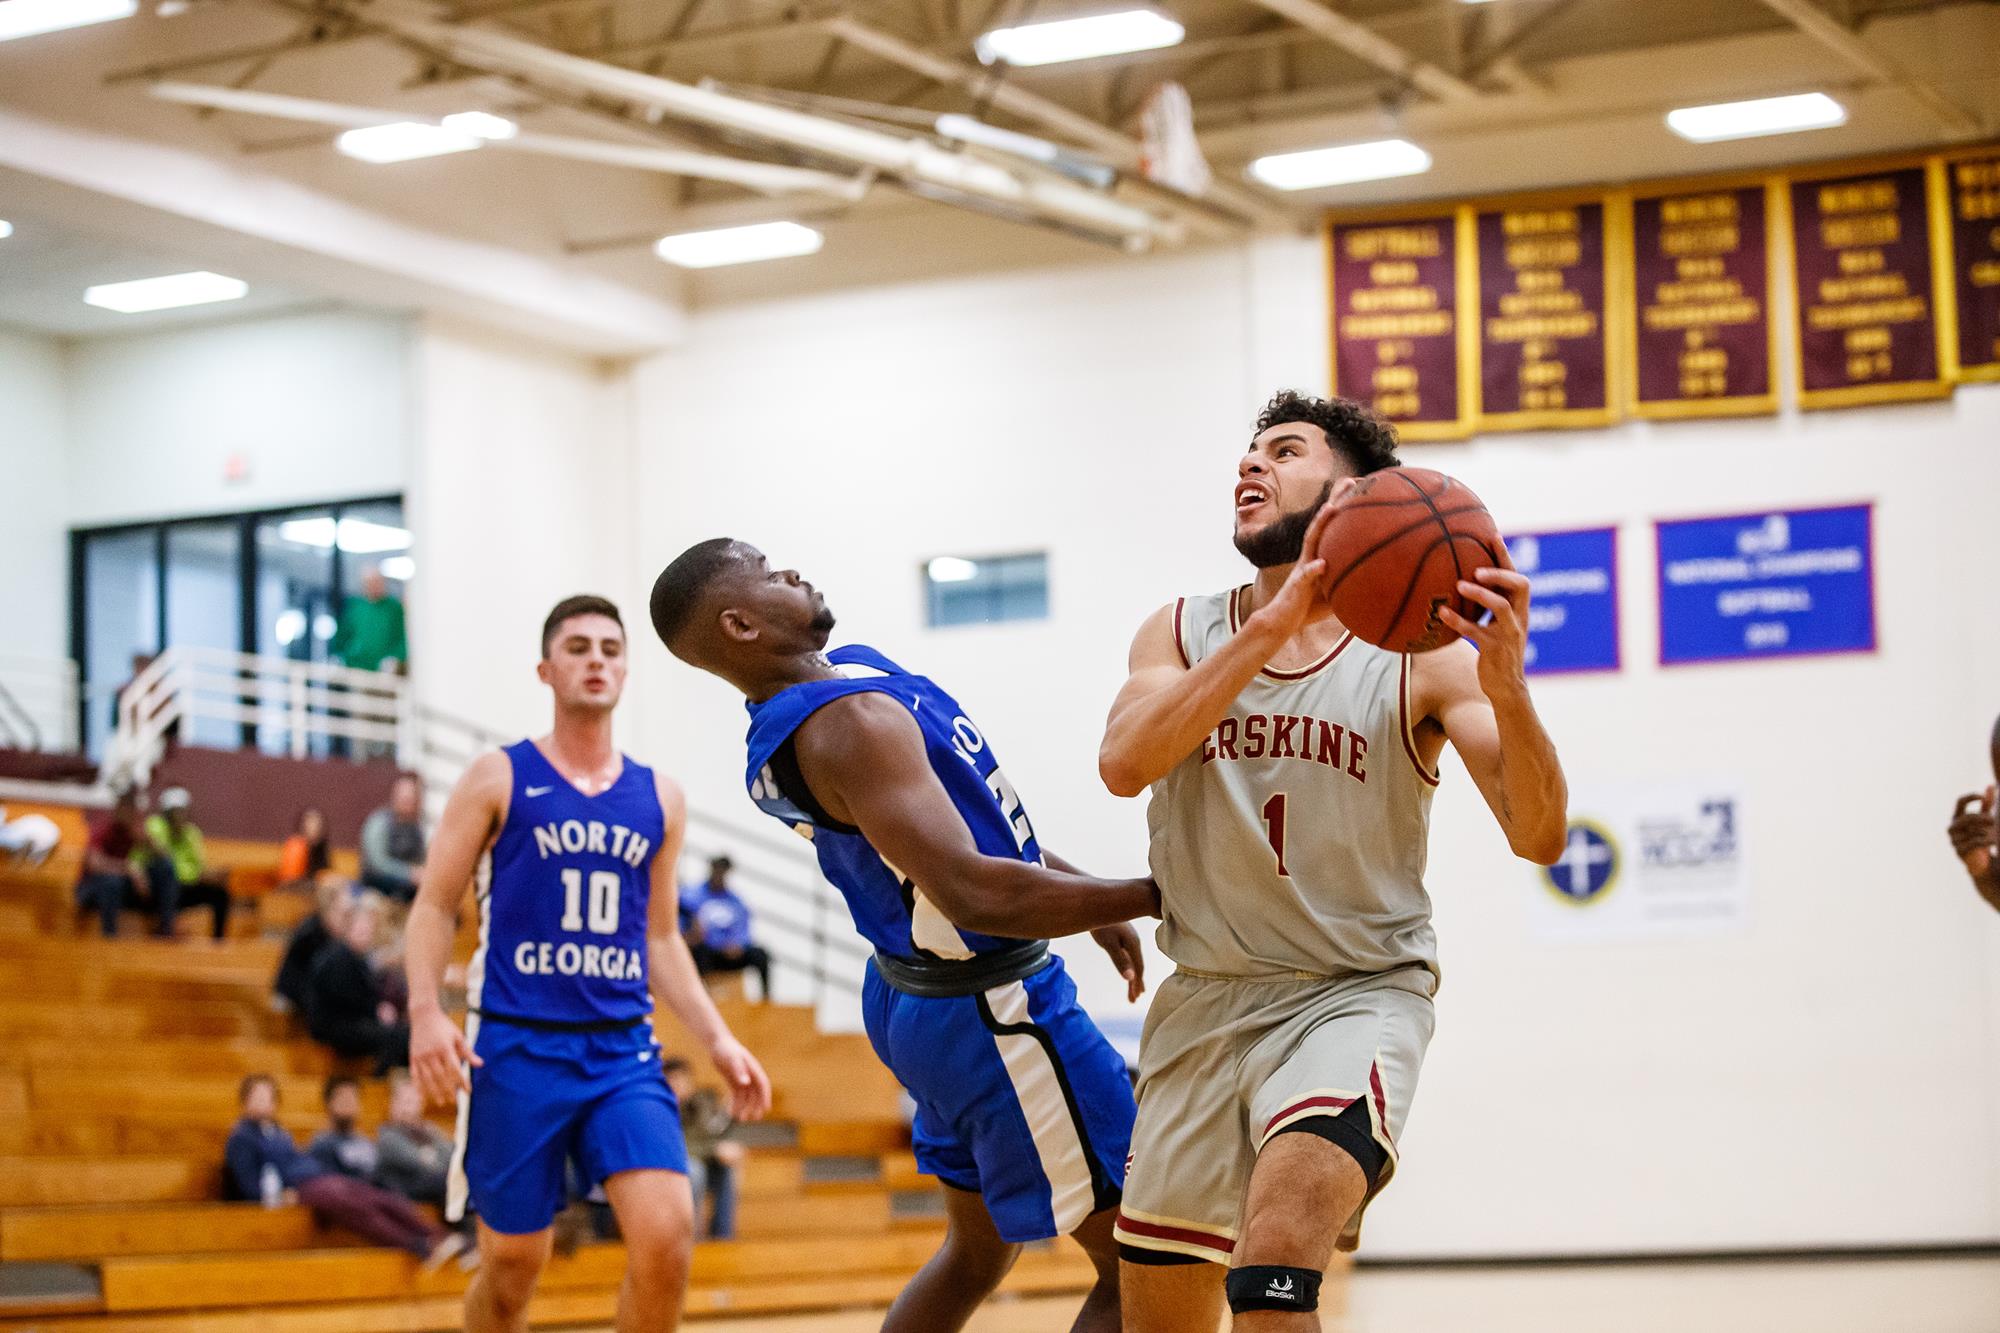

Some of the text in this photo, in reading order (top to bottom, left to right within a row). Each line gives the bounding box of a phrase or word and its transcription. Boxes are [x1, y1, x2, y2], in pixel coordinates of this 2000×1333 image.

[1202, 714, 1368, 784] ERSKINE
[533, 819, 649, 868] NORTH
[1263, 793, 1290, 878] 1
[560, 868, 620, 934] 10
[514, 942, 642, 980] GEORGIA
[1265, 1289, 1295, 1300] BioSkin
